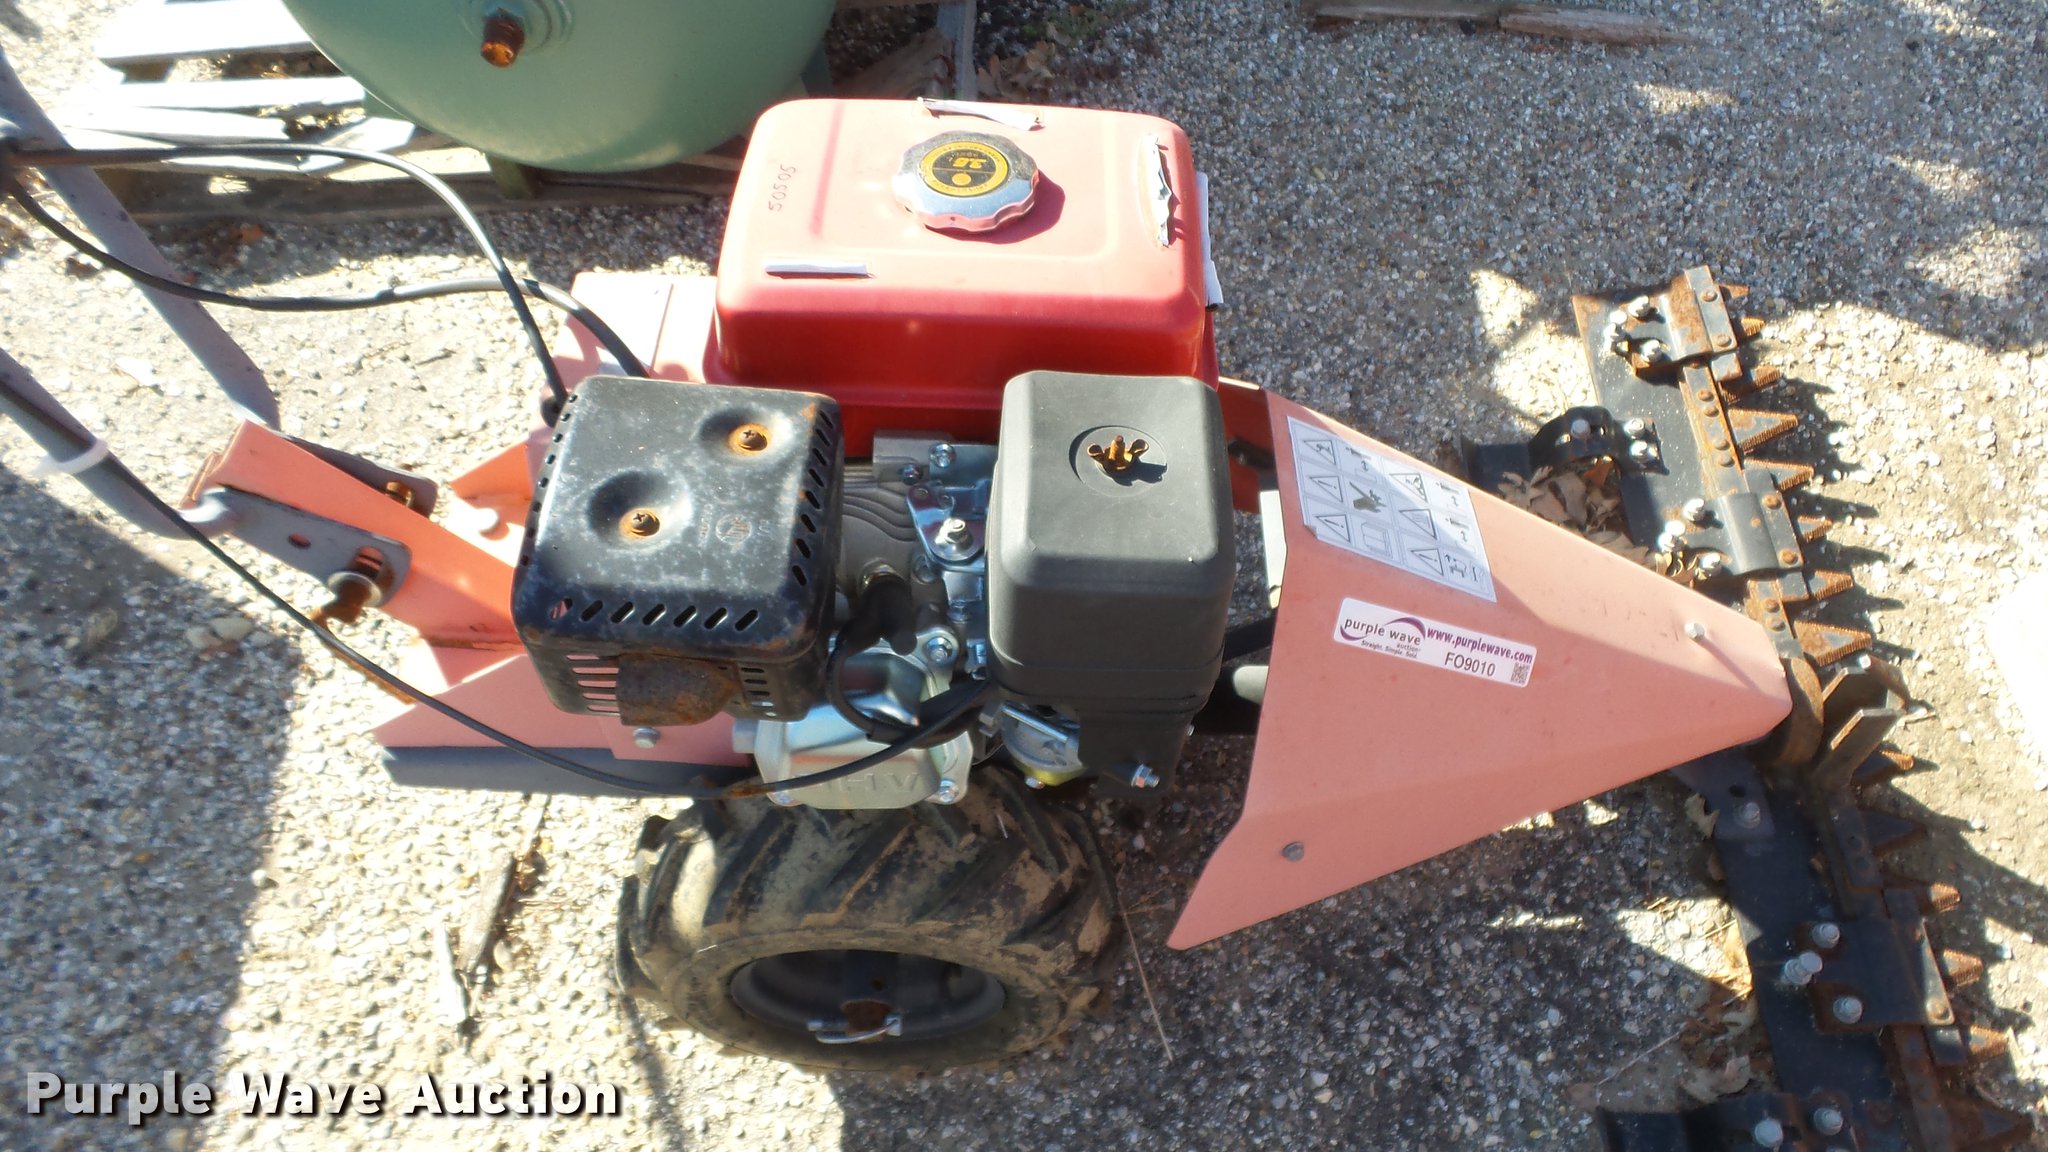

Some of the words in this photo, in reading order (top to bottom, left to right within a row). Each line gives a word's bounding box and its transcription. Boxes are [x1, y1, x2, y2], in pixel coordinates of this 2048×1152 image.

[768, 164, 796, 212] 50505
[1344, 618, 1385, 636] purple
[1389, 630, 1421, 645] wave
[1427, 626, 1533, 664] www.purplewave.com
[1444, 652, 1496, 677] FO9010
